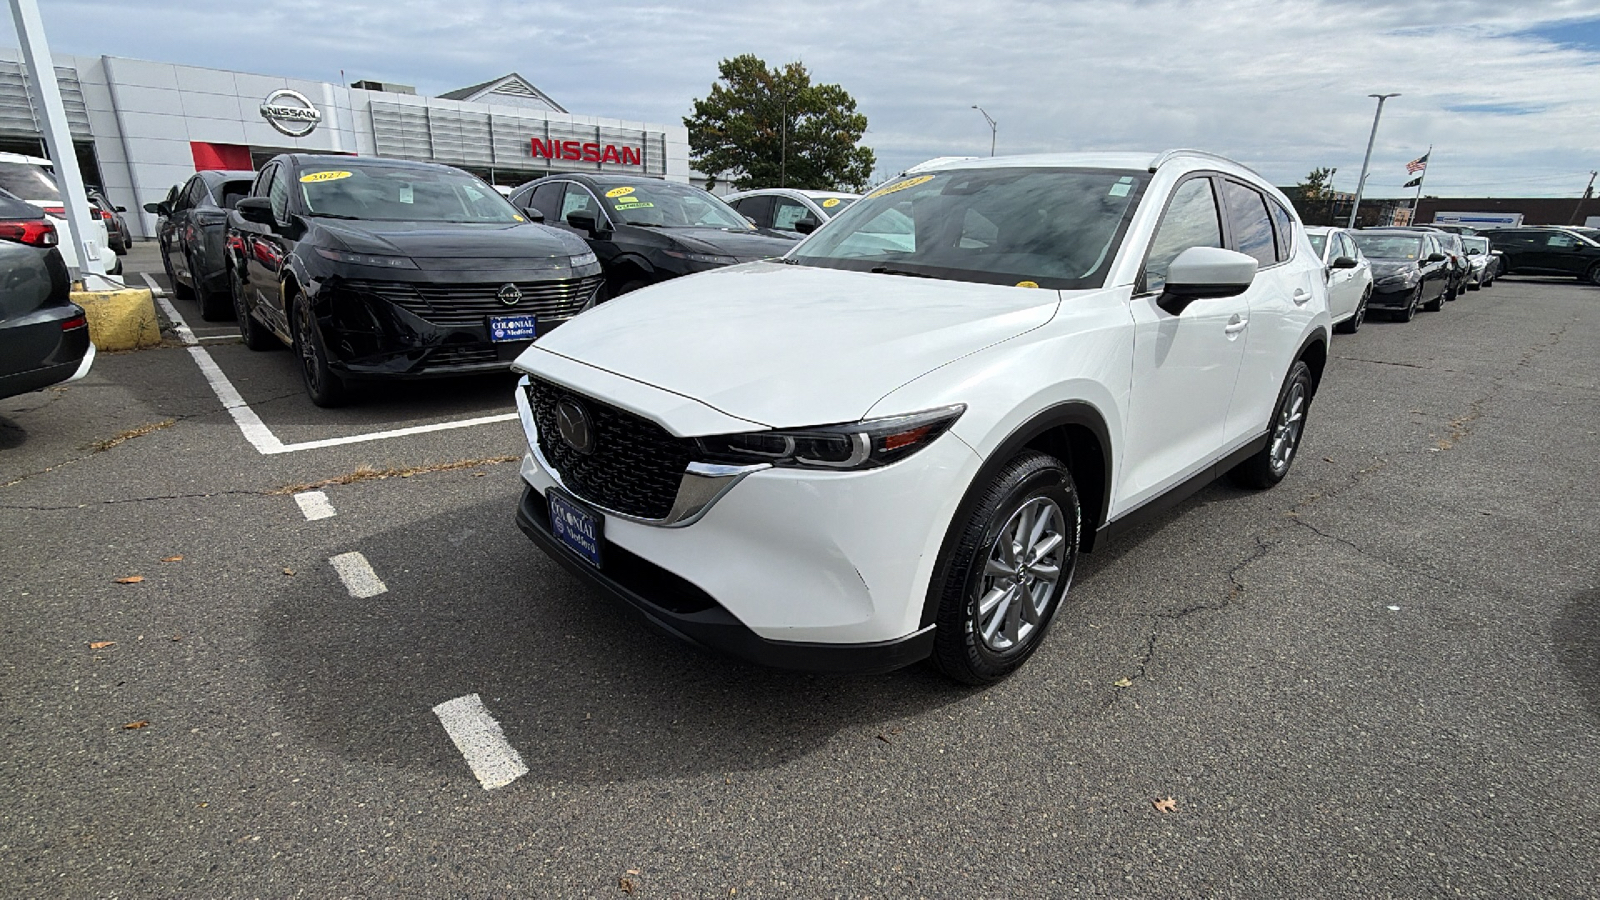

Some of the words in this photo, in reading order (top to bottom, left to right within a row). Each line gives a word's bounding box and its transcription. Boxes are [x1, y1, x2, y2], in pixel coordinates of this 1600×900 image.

[267, 106, 316, 119] NISSAN
[531, 137, 641, 166] NISSAN
[491, 319, 534, 330] COLONIAL
[506, 327, 533, 336] Medford
[551, 500, 596, 541] COLONIAL
[566, 524, 596, 555] Medford
